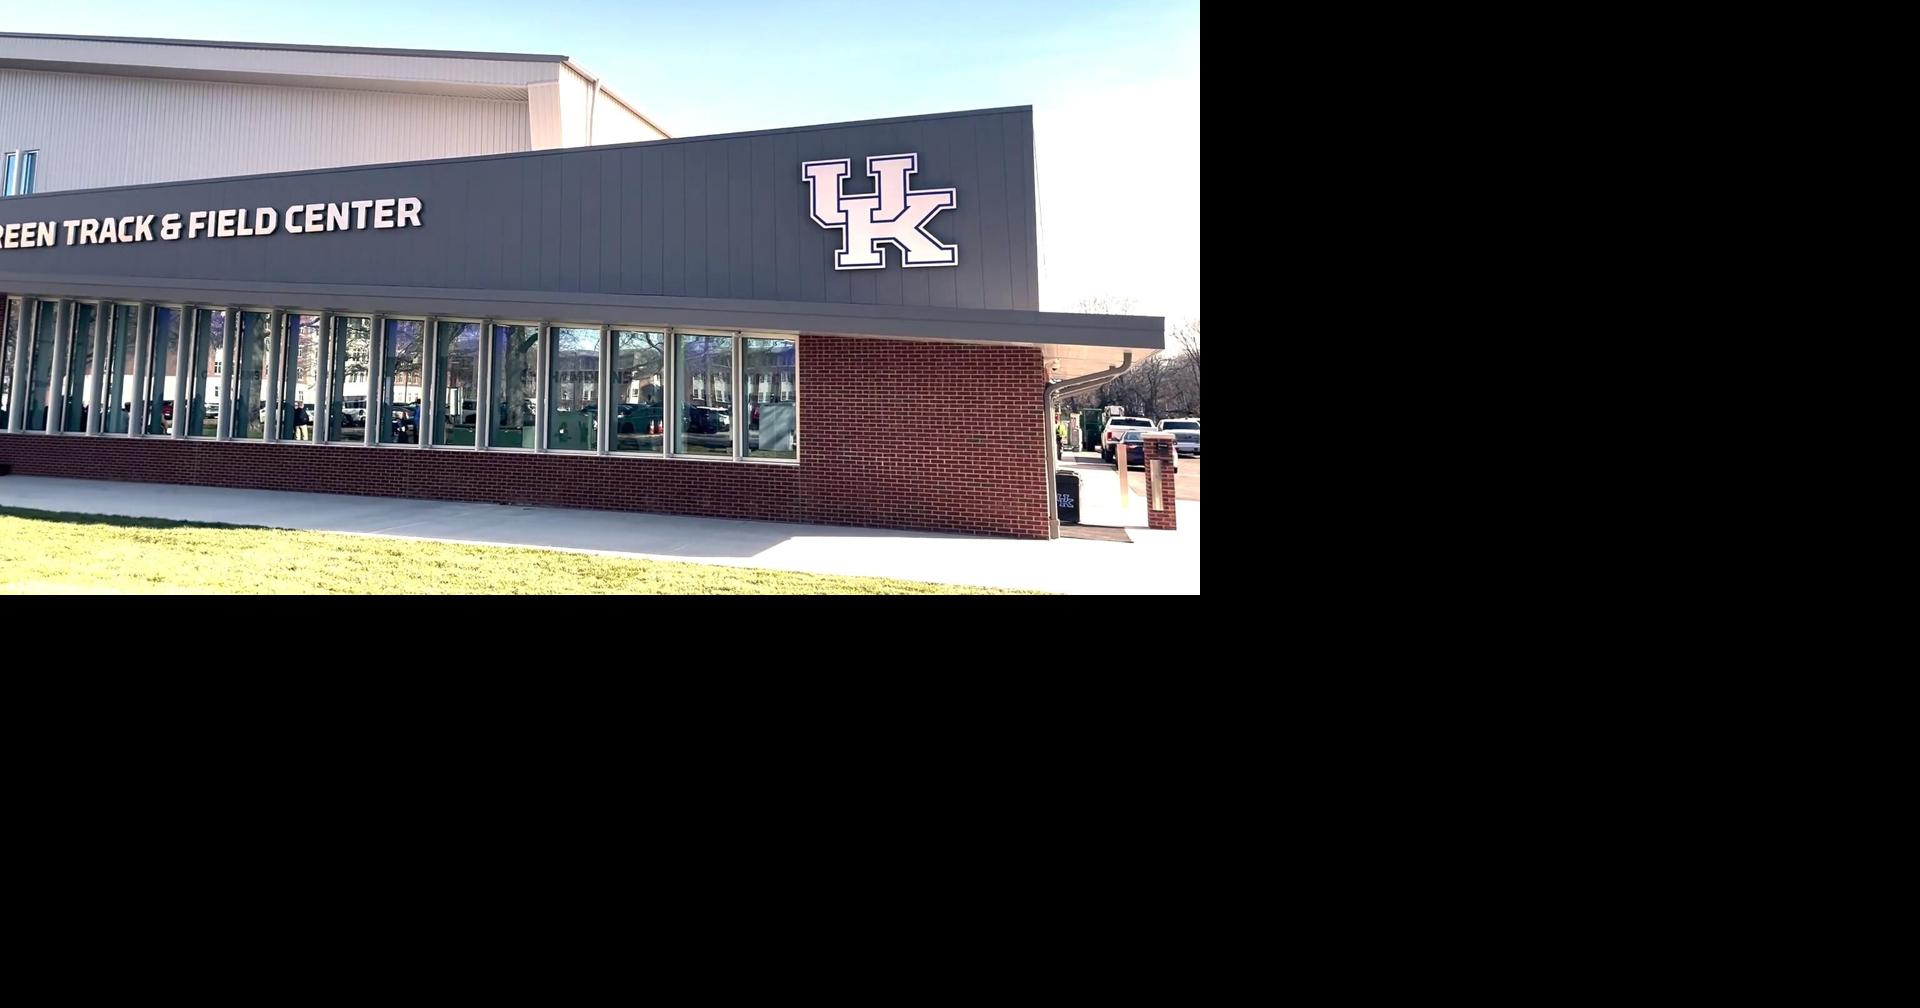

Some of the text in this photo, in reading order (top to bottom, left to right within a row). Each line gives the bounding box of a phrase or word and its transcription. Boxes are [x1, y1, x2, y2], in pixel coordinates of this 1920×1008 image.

[0, 197, 423, 249] EEN TRACK & FIELD CENTER
[801, 152, 958, 270] UK
